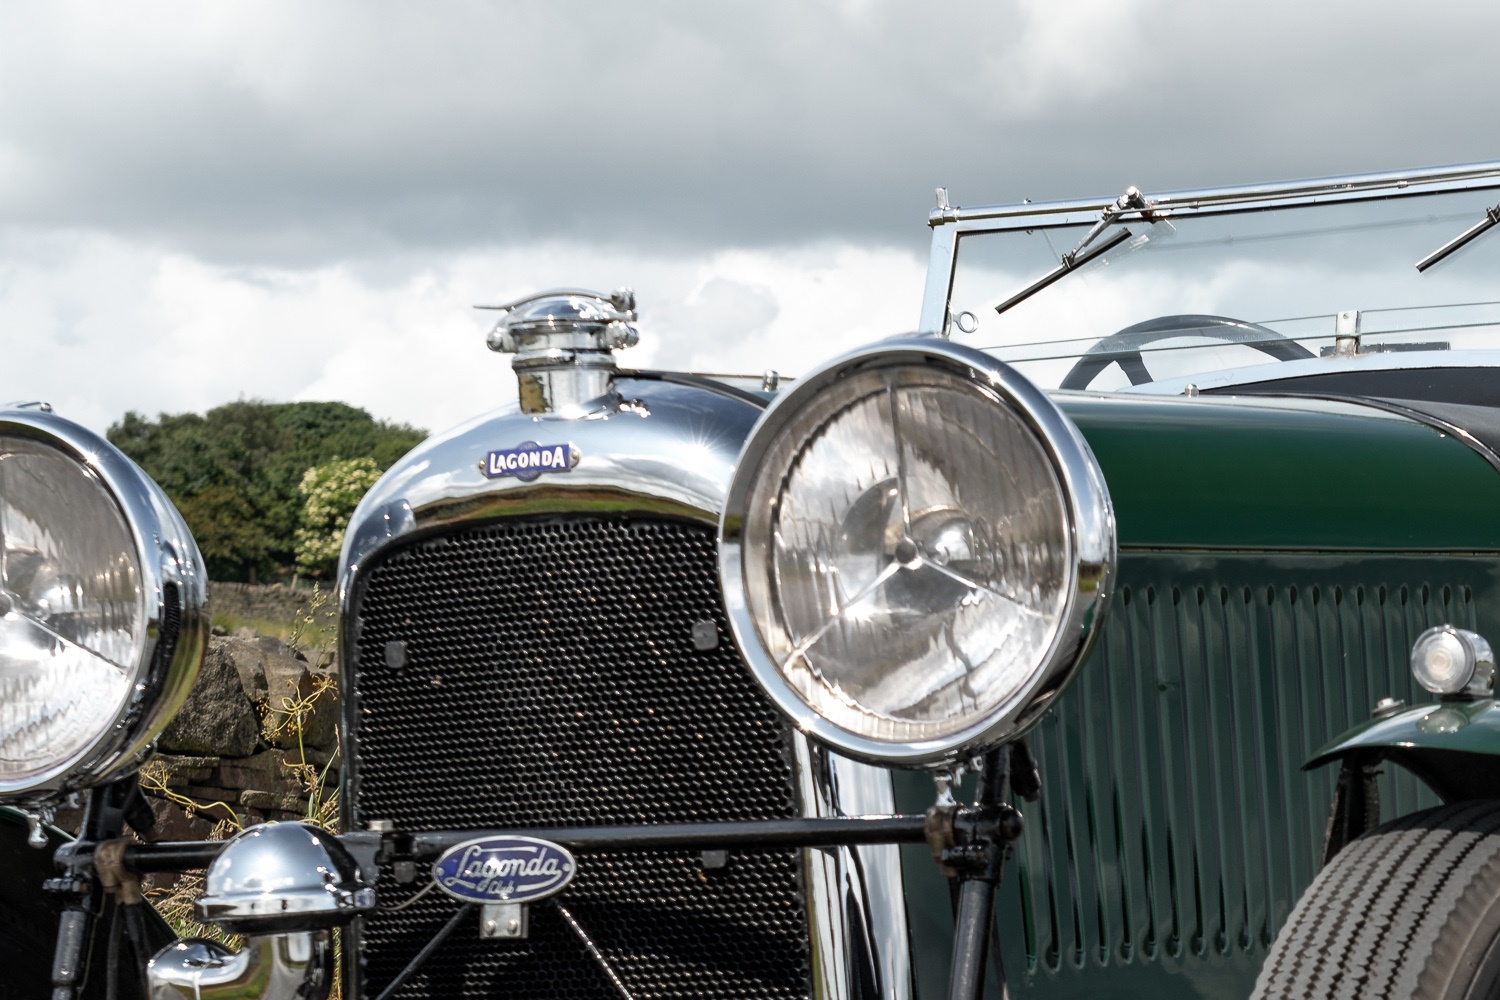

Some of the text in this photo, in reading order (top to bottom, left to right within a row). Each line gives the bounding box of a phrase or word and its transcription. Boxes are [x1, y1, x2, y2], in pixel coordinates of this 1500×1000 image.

[490, 446, 566, 474] LAGONDA
[446, 845, 562, 890] Lagonda
[486, 880, 515, 895] Club
